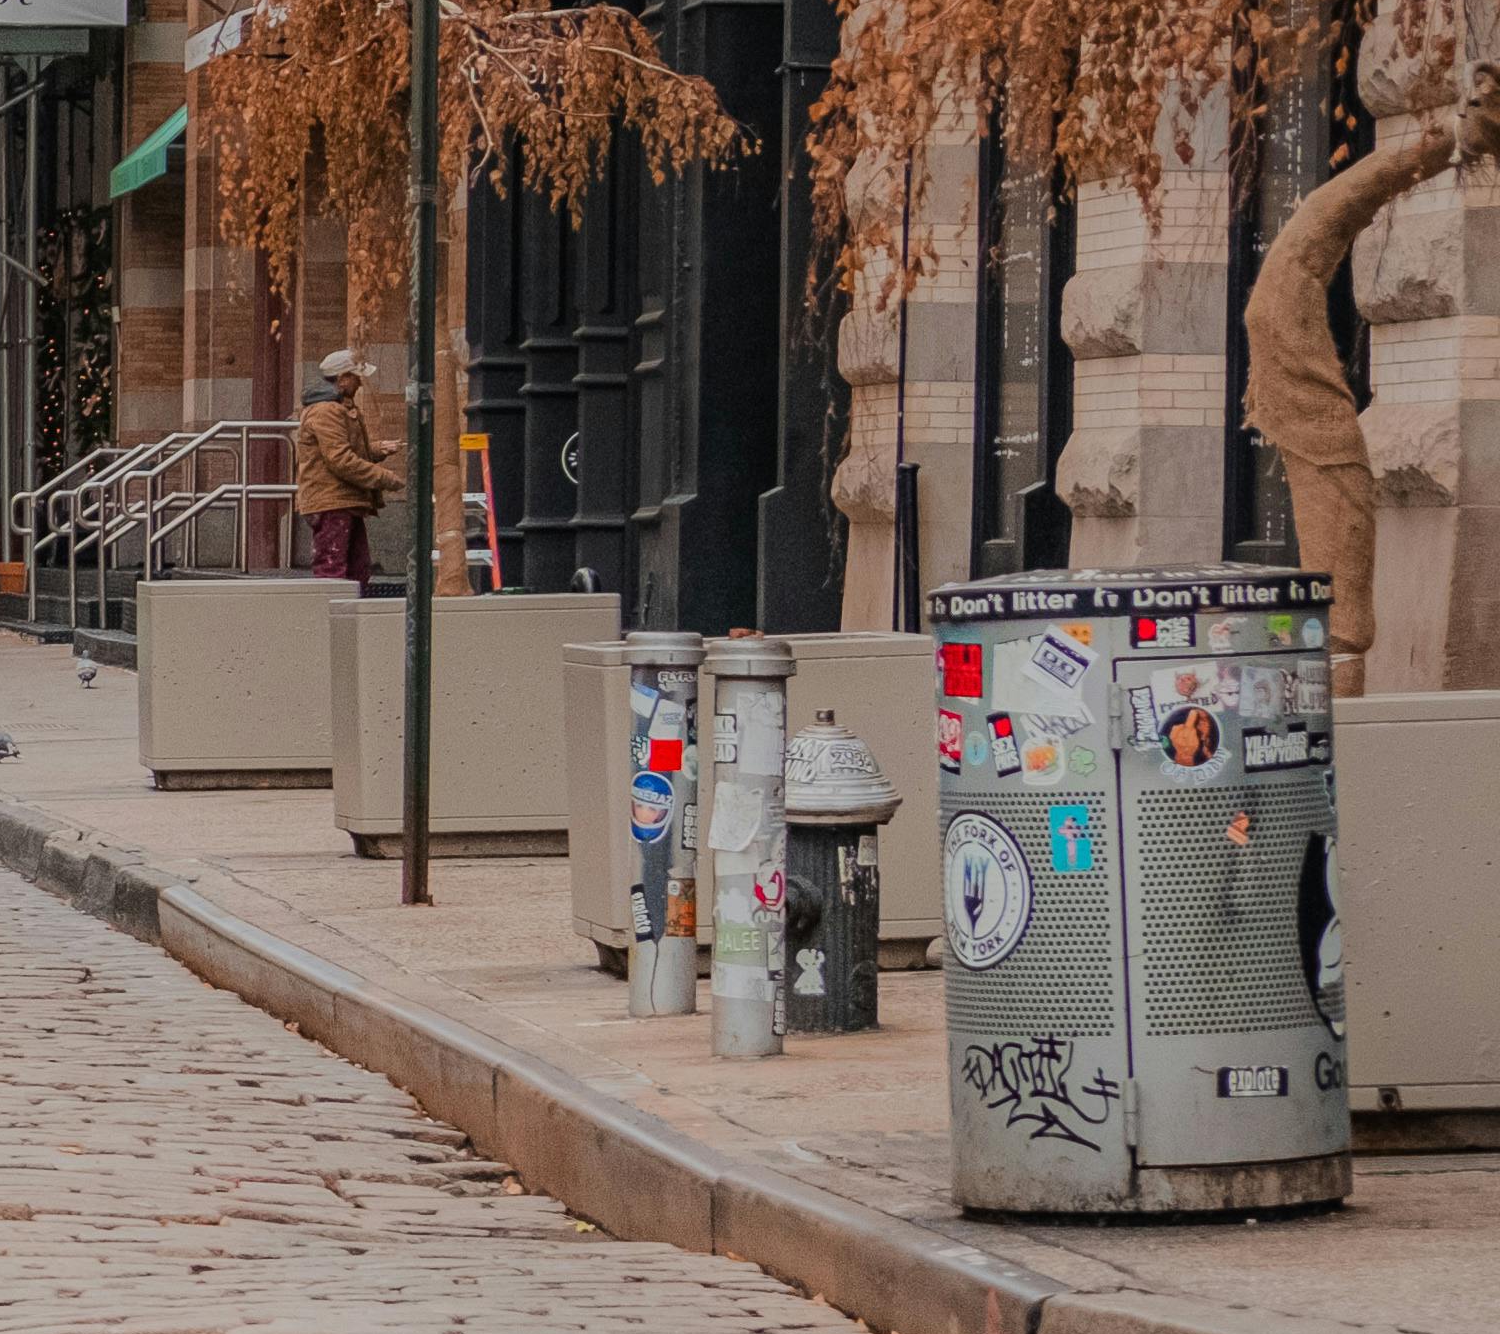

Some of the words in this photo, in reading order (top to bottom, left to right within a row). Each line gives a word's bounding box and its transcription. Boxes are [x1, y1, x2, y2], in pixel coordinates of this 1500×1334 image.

[950, 593, 1005, 616] Don't
[1012, 591, 1078, 612] litter
[1132, 585, 1211, 608] Don't
[1221, 584, 1279, 605] litter
[964, 824, 998, 849] FORK
[999, 849, 1017, 873] OF
[972, 933, 1005, 957] YORK
